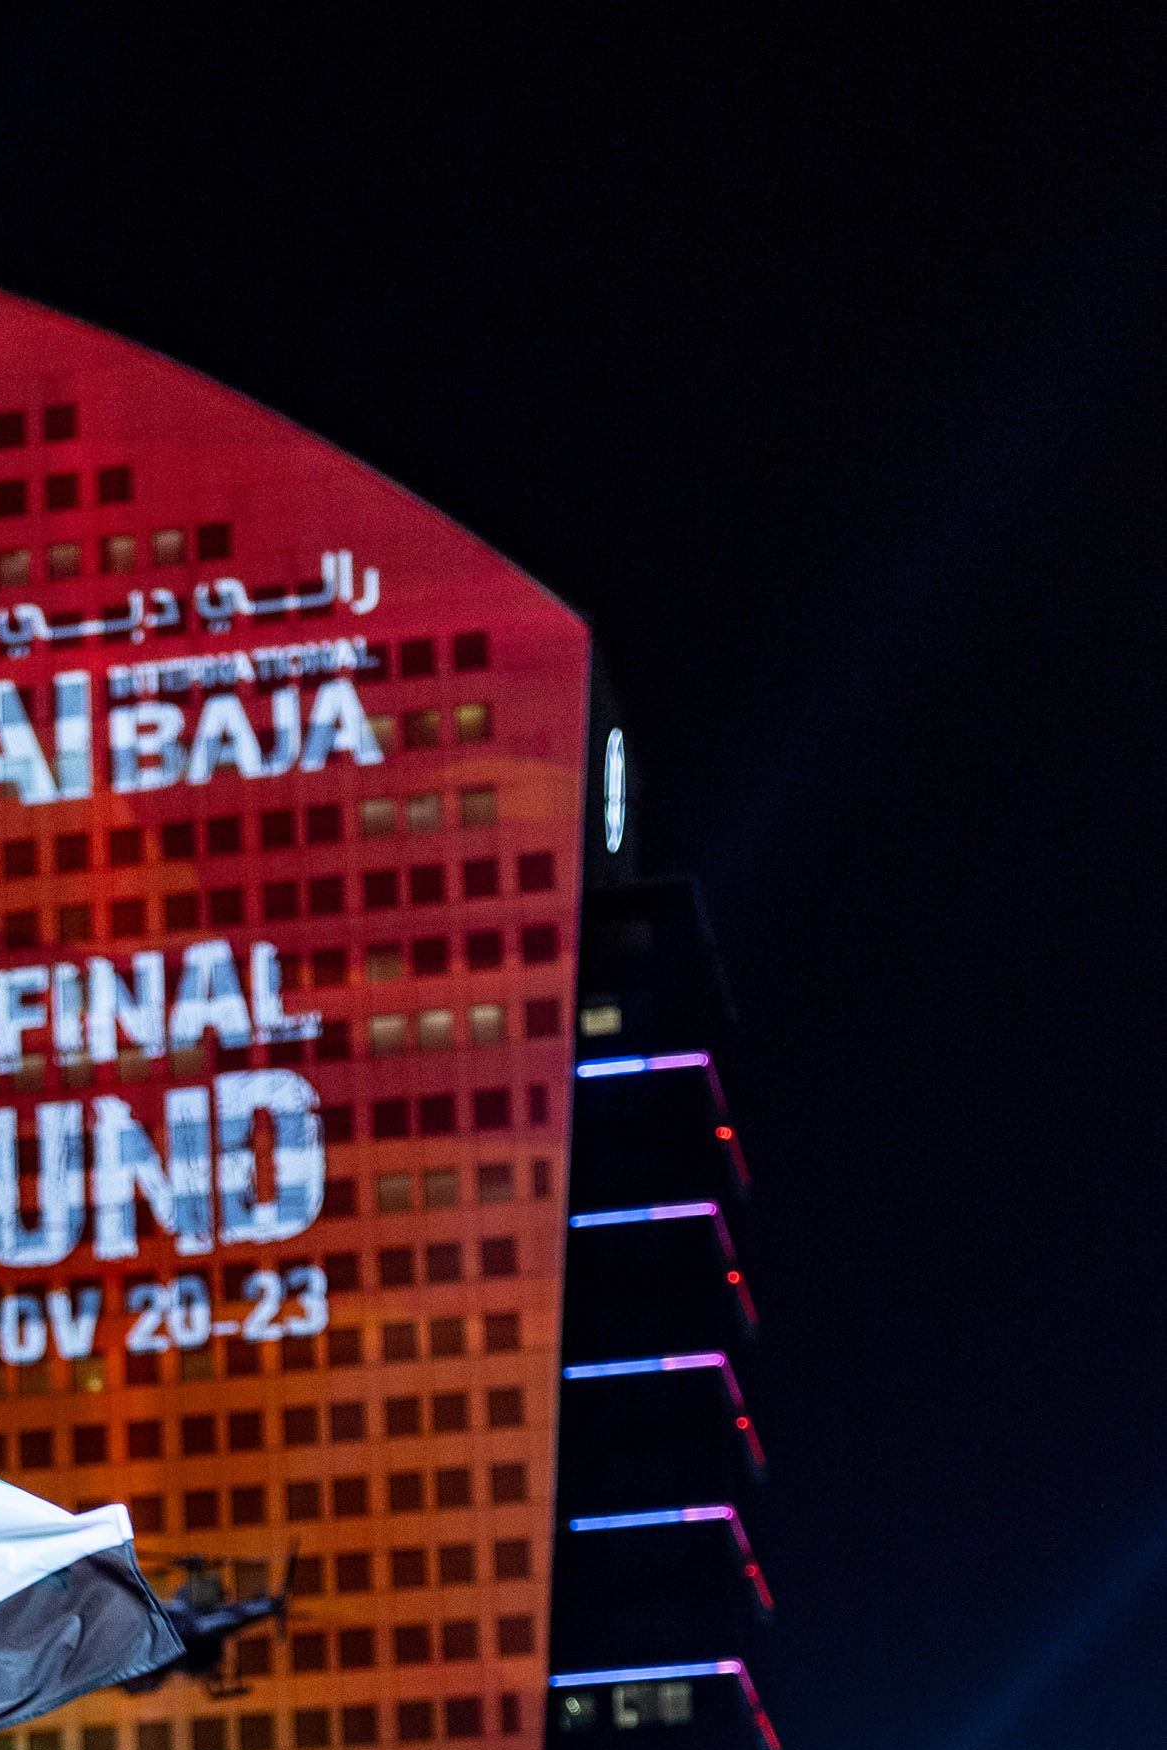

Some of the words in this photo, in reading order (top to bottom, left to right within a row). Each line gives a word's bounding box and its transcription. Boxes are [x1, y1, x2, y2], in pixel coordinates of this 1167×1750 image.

[194, 550, 381, 634] رالي
[107, 636, 381, 699] INTERNATIONAL
[109, 678, 385, 795] BAJA
[125, 1265, 331, 1355] 20-23
